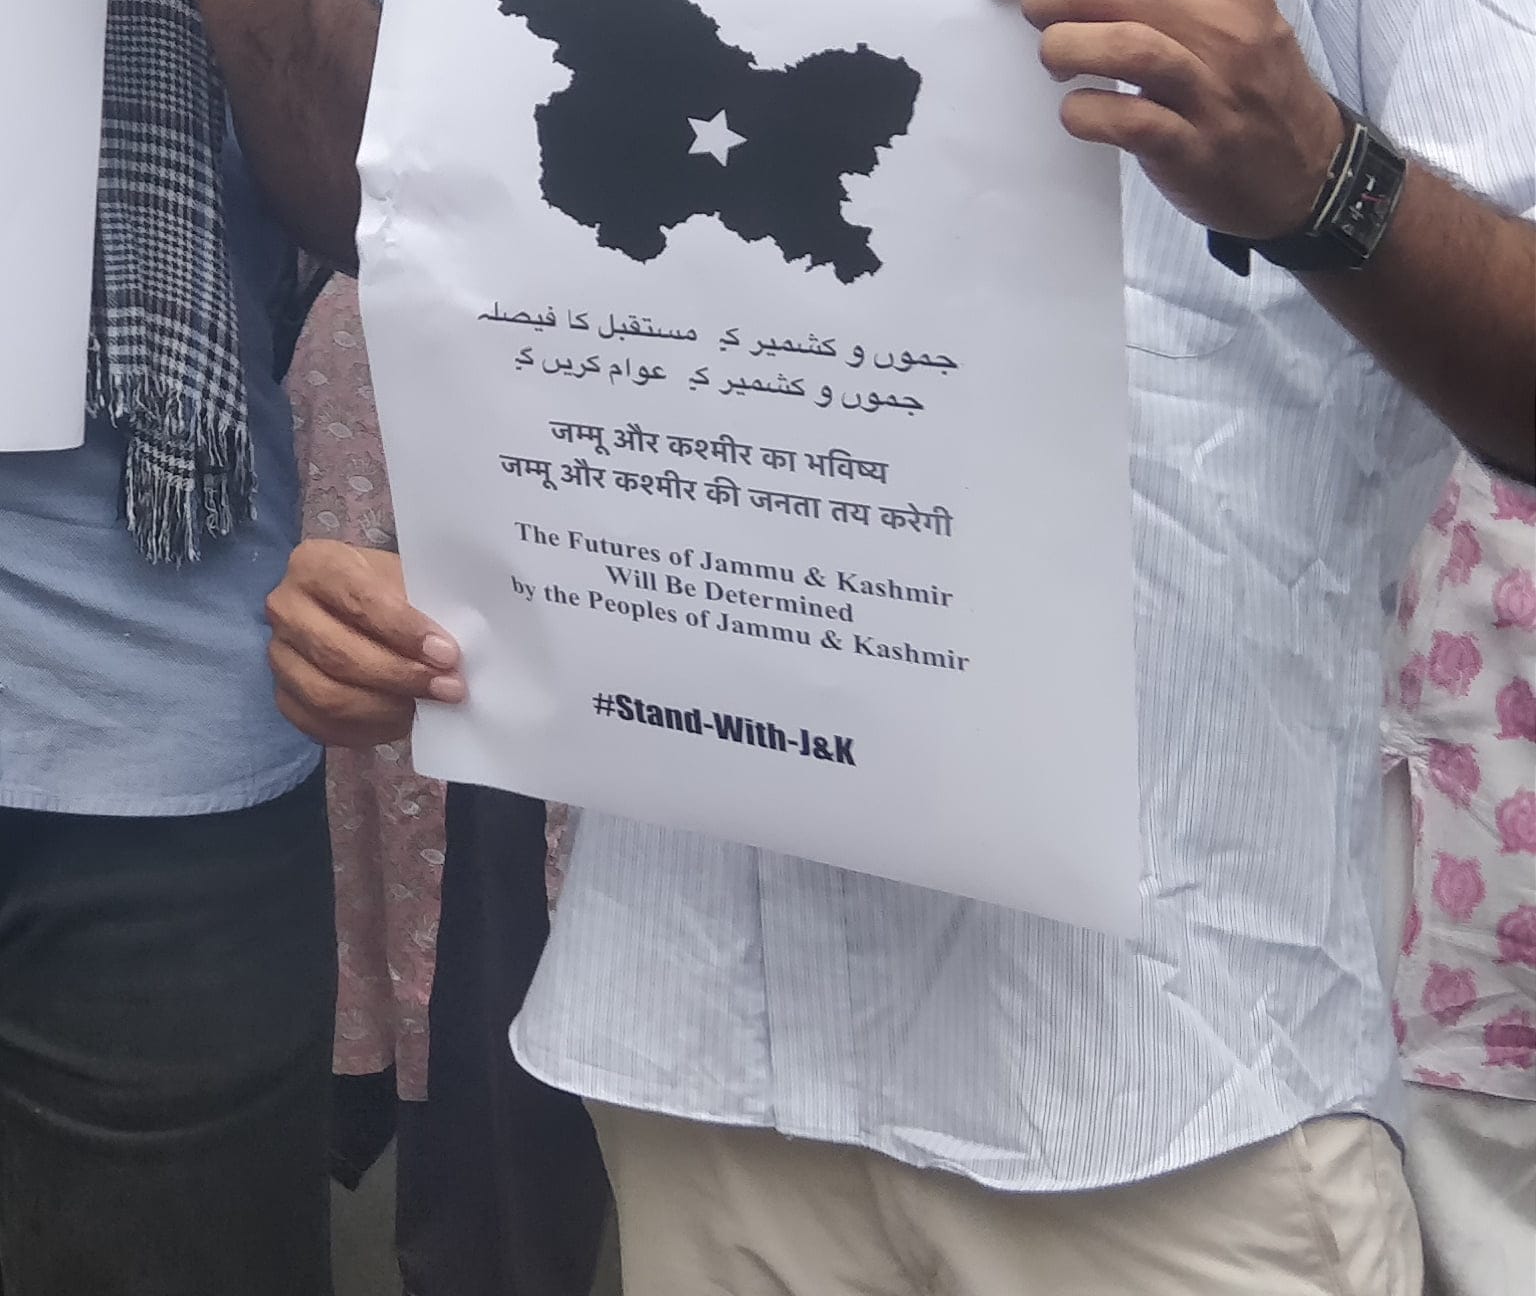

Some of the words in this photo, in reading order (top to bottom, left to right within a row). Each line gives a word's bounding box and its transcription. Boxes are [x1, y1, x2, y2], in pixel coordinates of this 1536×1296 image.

[567, 309, 590, 331] کا
[597, 313, 698, 342] مستقبل
[608, 357, 667, 387] عوام
[548, 420, 611, 457] जम्मू
[613, 422, 661, 454] और
[665, 433, 754, 466] कश्मीर
[759, 447, 798, 473] का
[803, 448, 890, 485] भविष्य
[498, 454, 559, 491] जम्मू
[560, 457, 607, 489] और
[611, 469, 698, 502] कश्मीर
[703, 475, 742, 508] की
[746, 488, 823, 519] जनता
[828, 499, 873, 527] तय
[877, 502, 955, 538] करेगी
[513, 521, 560, 547] The
[567, 530, 661, 563] Futures
[668, 548, 695, 568] of
[699, 550, 795, 584] Jammu
[803, 566, 827, 588] &
[836, 570, 954, 607] Kashmir
[604, 564, 658, 592] Will
[664, 574, 697, 598] Be
[704, 580, 854, 623] Determined
[510, 574, 537, 602] by
[543, 584, 581, 607] the
[587, 590, 678, 624] Peoples
[685, 609, 711, 629] of
[715, 612, 812, 646] Jammu
[819, 629, 843, 651] &
[853, 634, 971, 672] Kashmir
